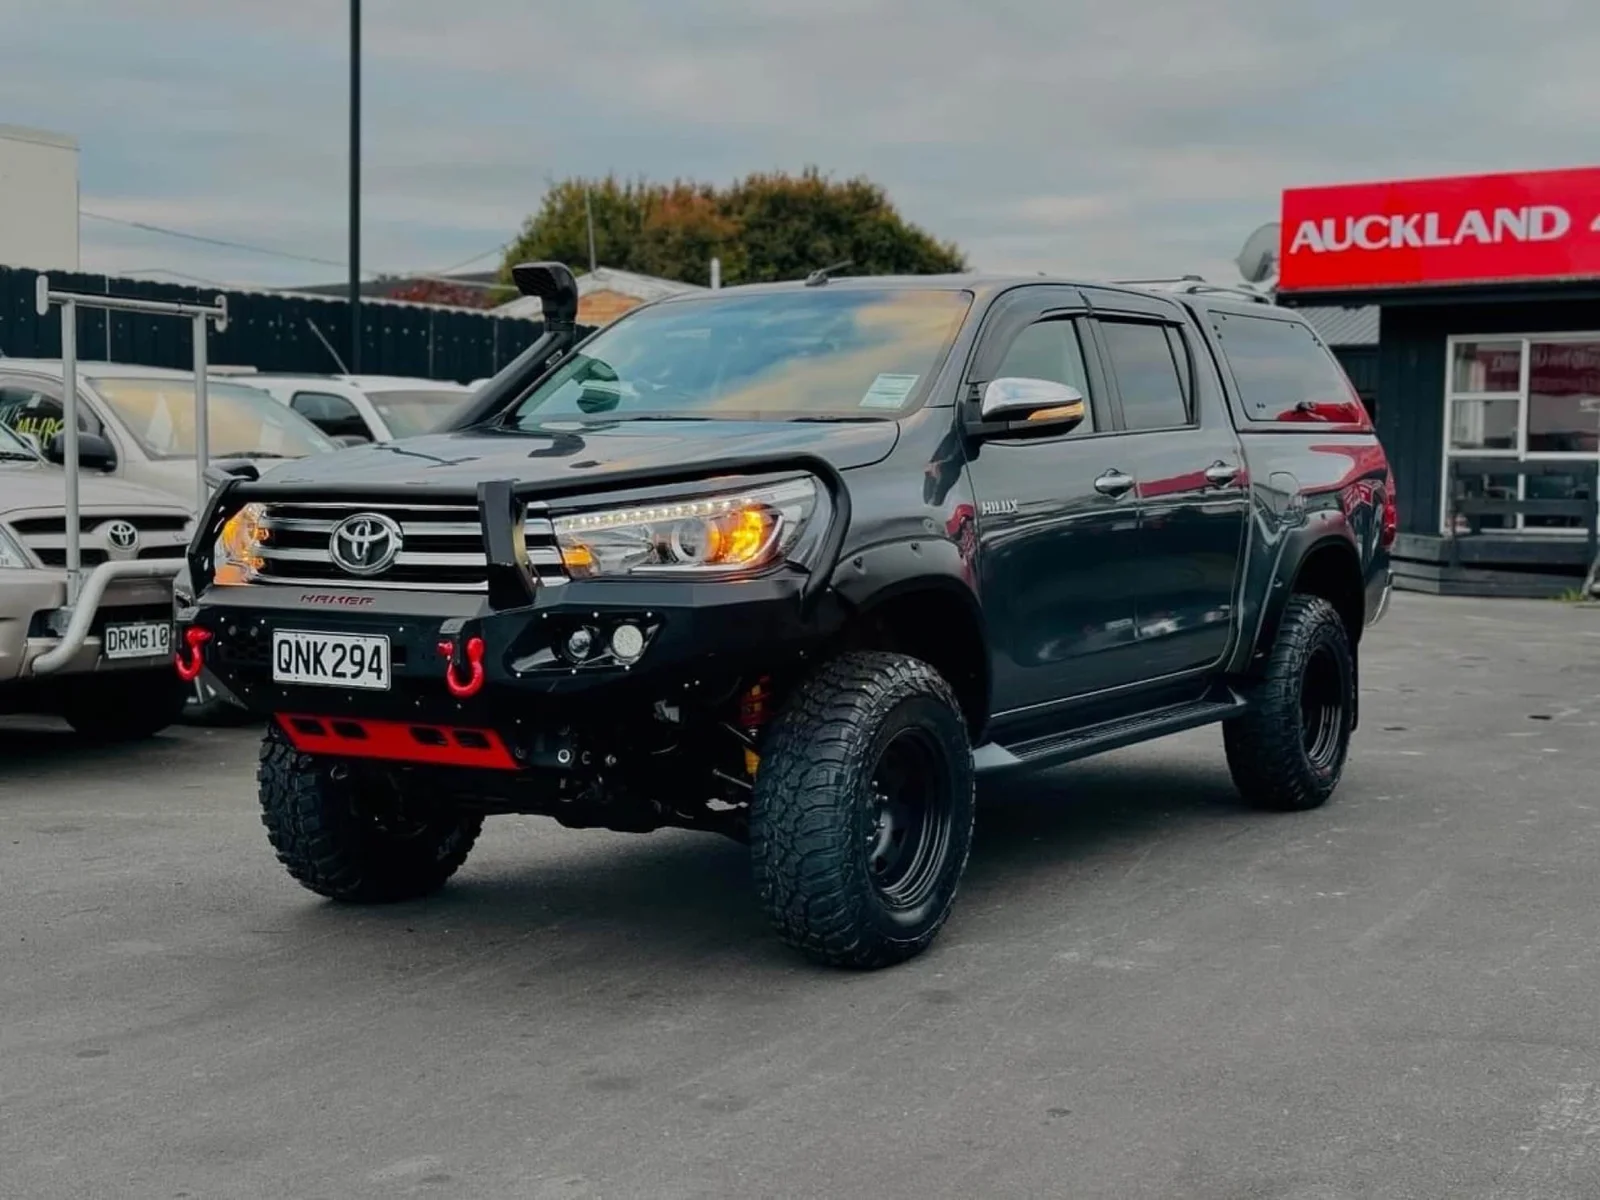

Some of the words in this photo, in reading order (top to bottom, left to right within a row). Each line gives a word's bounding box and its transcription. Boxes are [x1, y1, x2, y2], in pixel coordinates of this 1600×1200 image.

[1289, 205, 1571, 255] AUCKLAND
[982, 499, 1017, 515] HILUX
[107, 627, 168, 651] DRM610
[277, 639, 382, 681] QNK294
